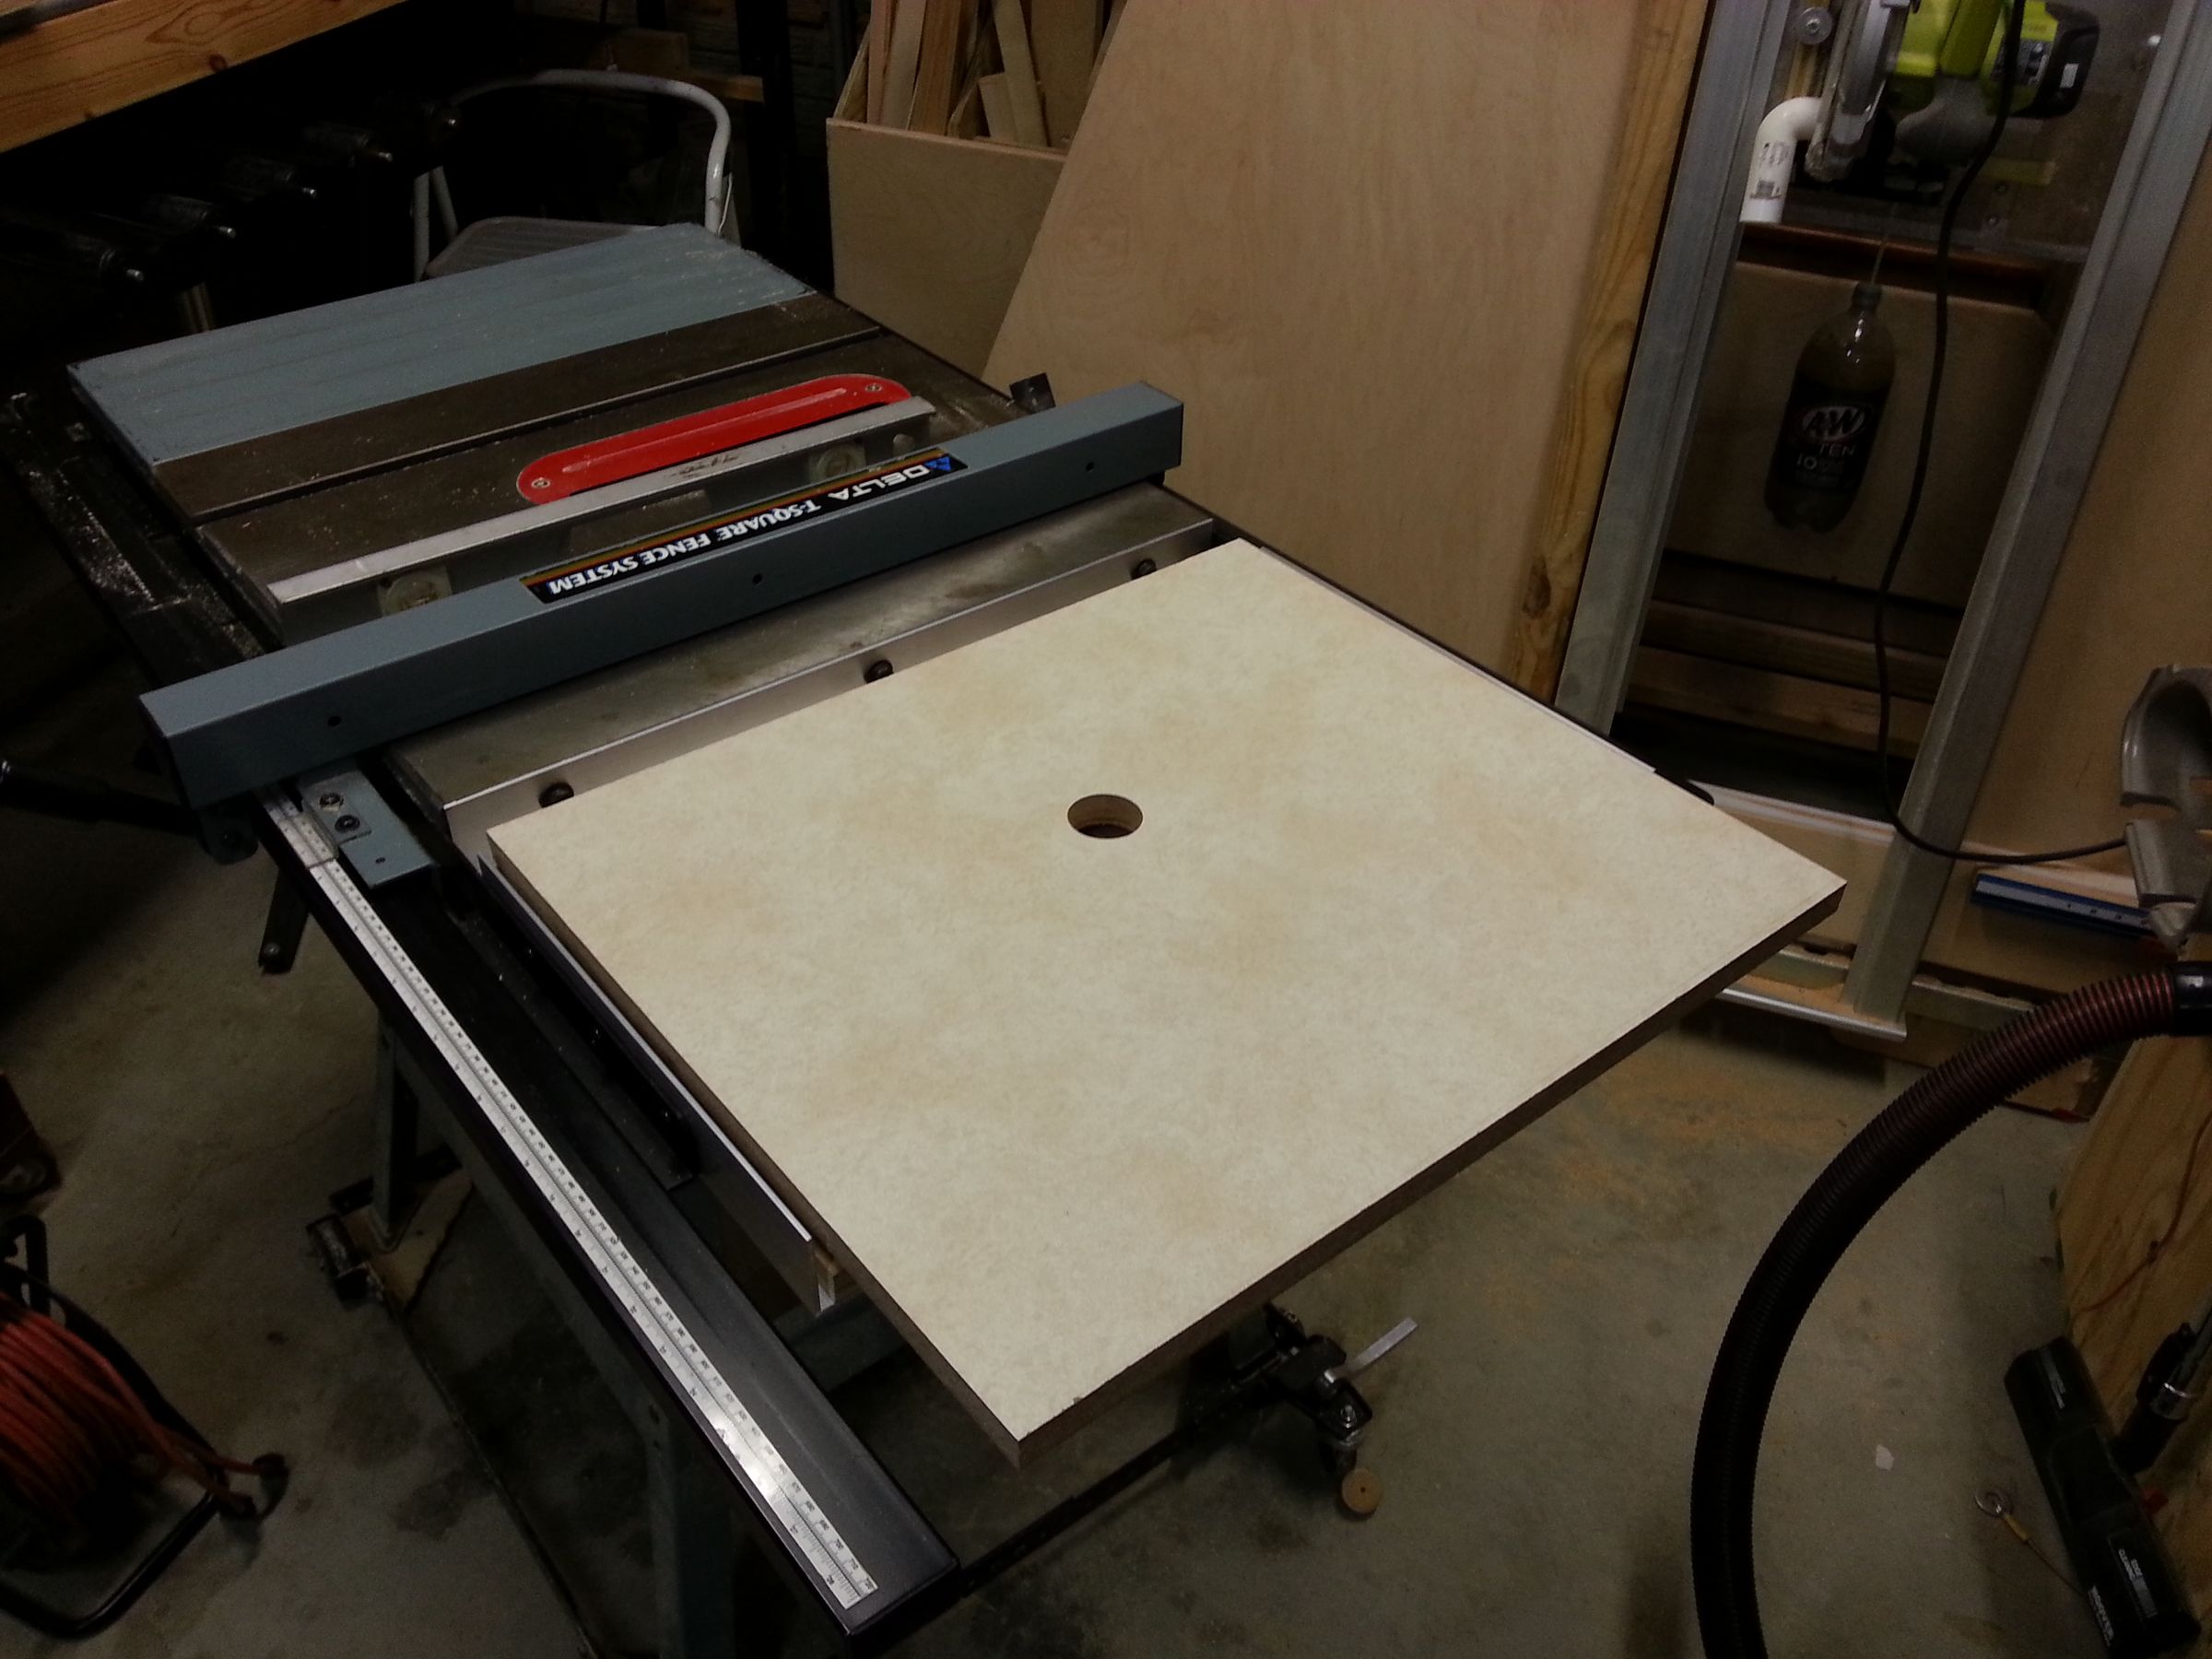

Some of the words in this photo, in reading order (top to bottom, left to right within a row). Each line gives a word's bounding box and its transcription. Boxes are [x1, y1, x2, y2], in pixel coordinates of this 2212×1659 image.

[1818, 443, 1857, 457] TEN
[827, 464, 931, 501] DELTA
[716, 499, 821, 541] T-SQUARE
[640, 532, 712, 566] FENCE
[547, 555, 640, 595] SYSTEM
